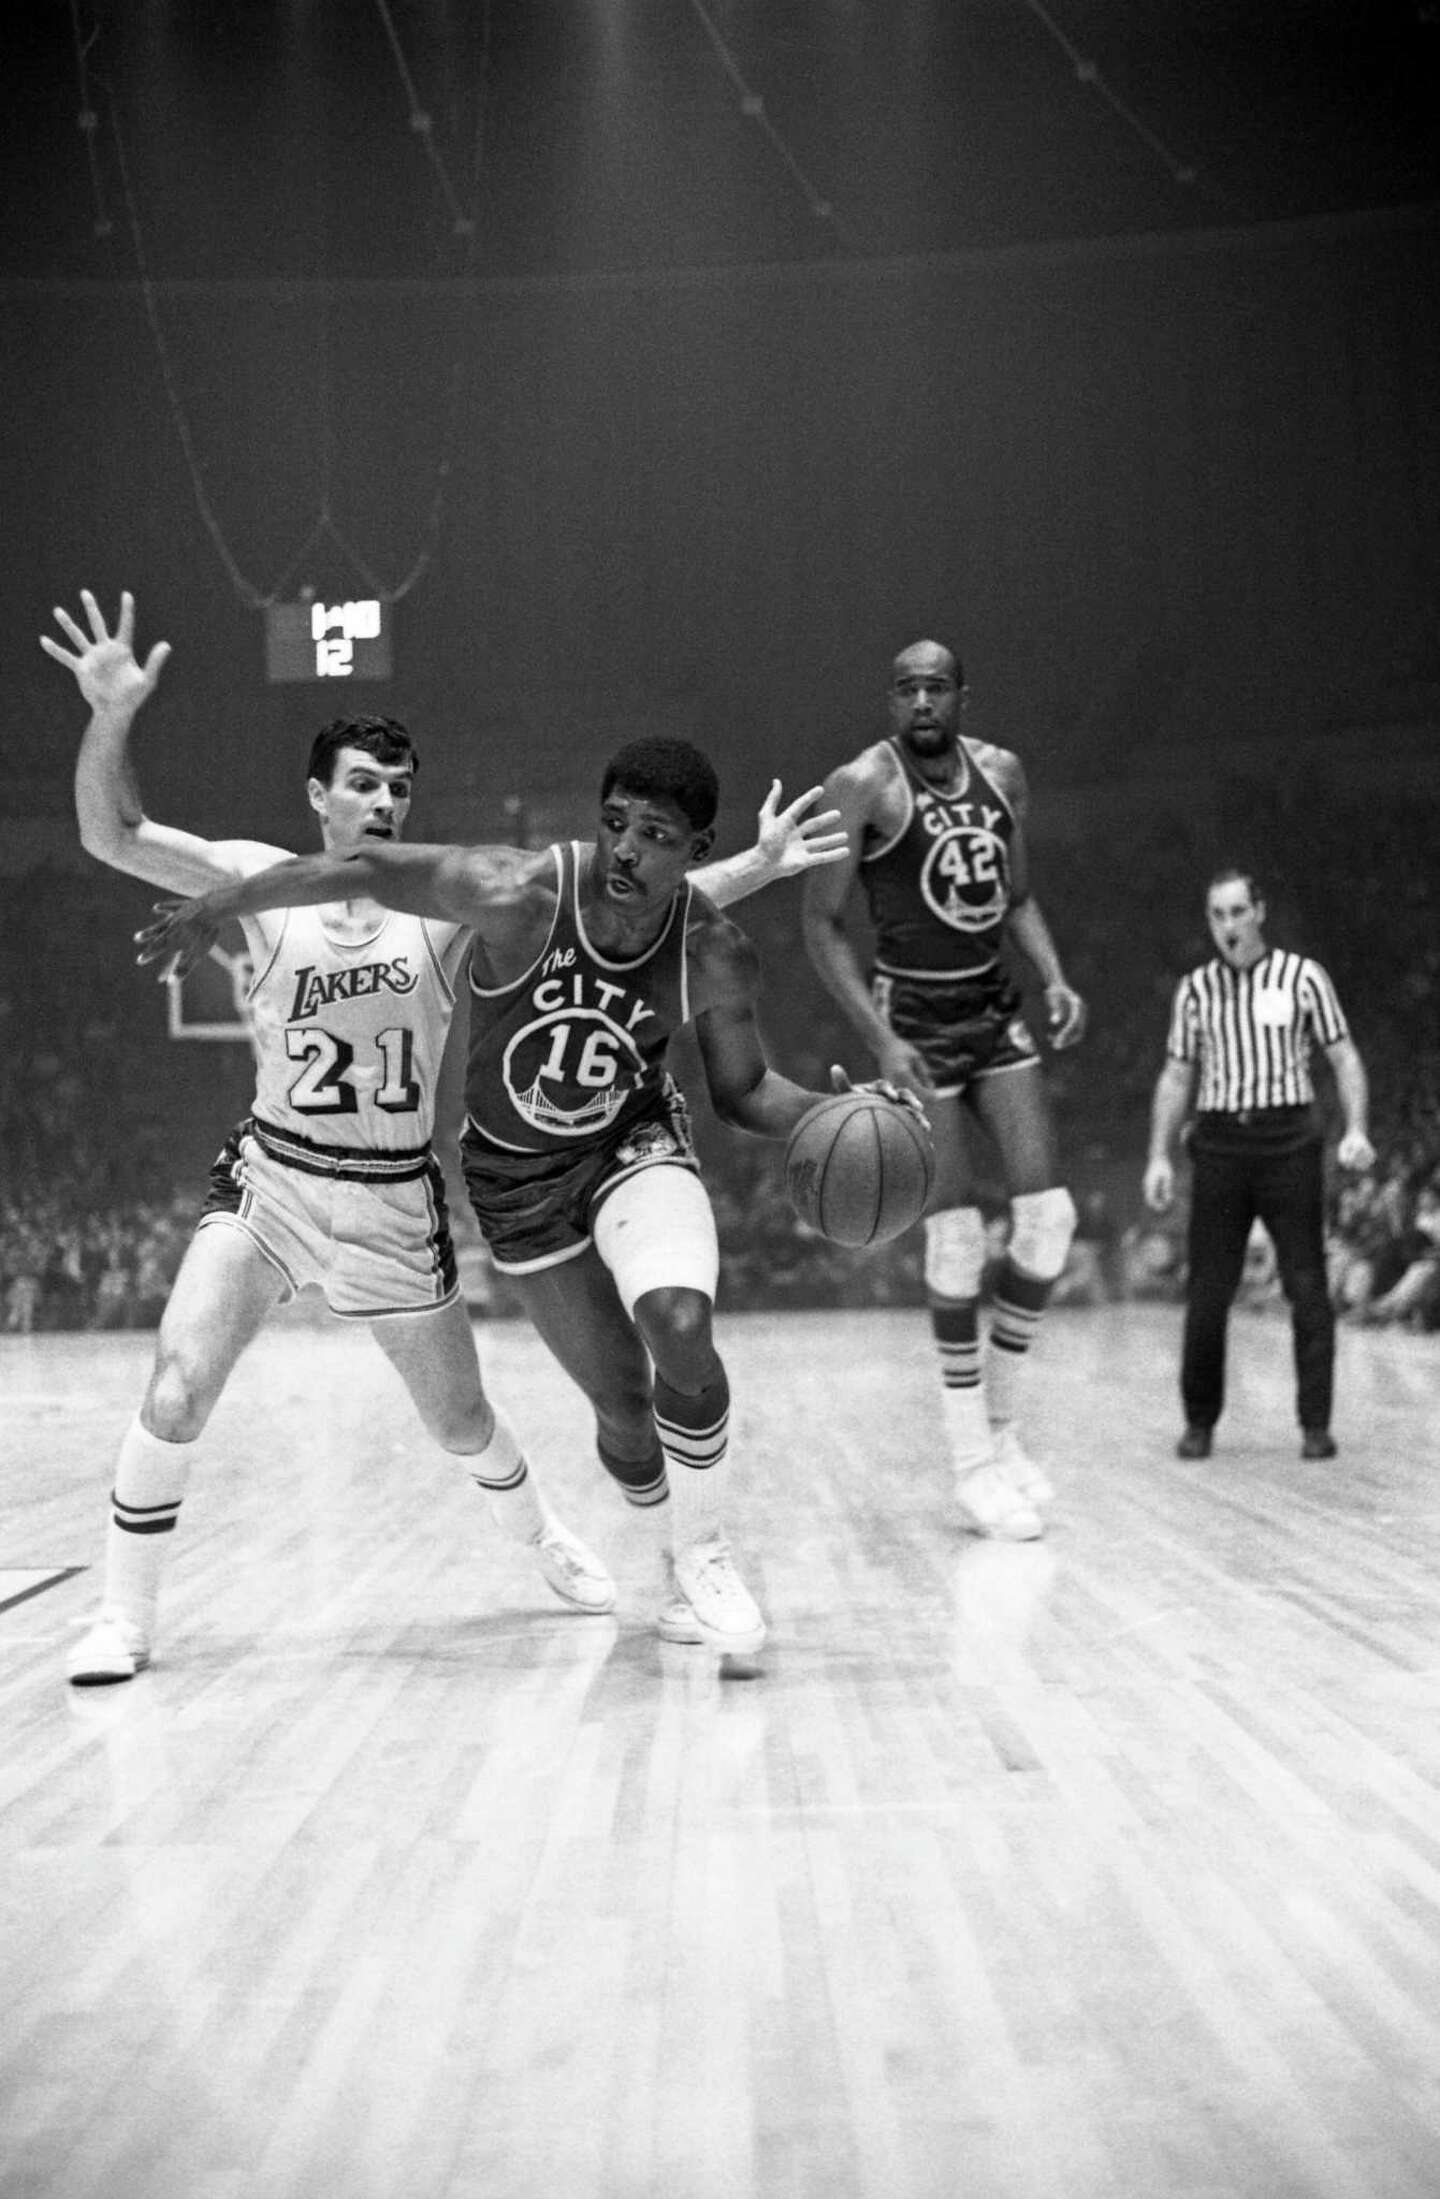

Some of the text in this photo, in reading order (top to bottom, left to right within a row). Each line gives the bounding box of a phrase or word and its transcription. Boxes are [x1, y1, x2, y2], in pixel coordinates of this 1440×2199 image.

[923, 803, 1002, 836] CITY
[939, 837, 999, 886] 42
[287, 957, 419, 1023] LAKERS
[532, 974, 656, 1031] CITY
[285, 1027, 421, 1116] 21
[540, 1024, 620, 1087] 16
